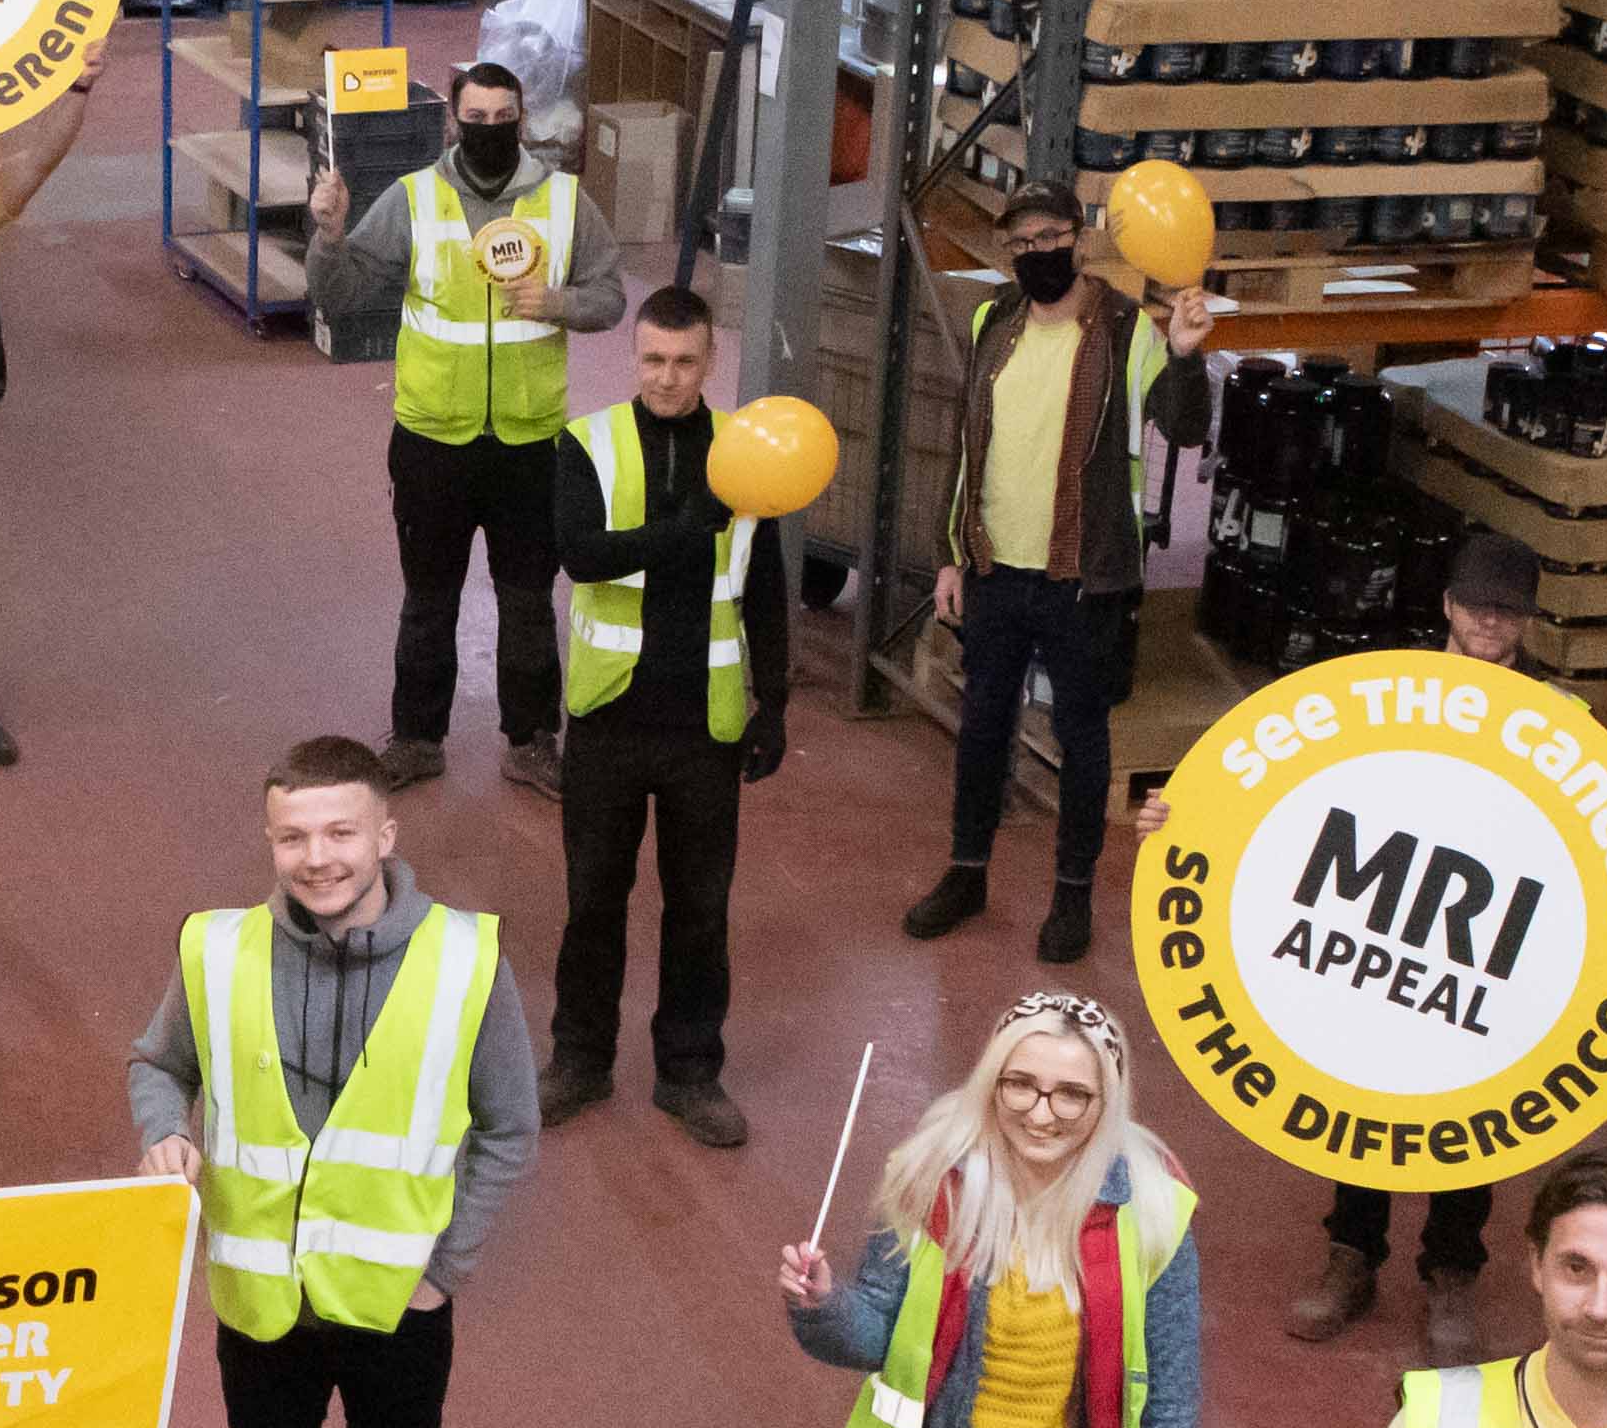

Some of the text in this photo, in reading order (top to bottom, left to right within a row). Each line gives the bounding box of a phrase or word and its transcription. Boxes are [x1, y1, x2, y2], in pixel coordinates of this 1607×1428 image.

[491, 239, 524, 259] MRI
[1292, 807, 1544, 981] MRI
[1271, 919, 1490, 1037] APPEAL
